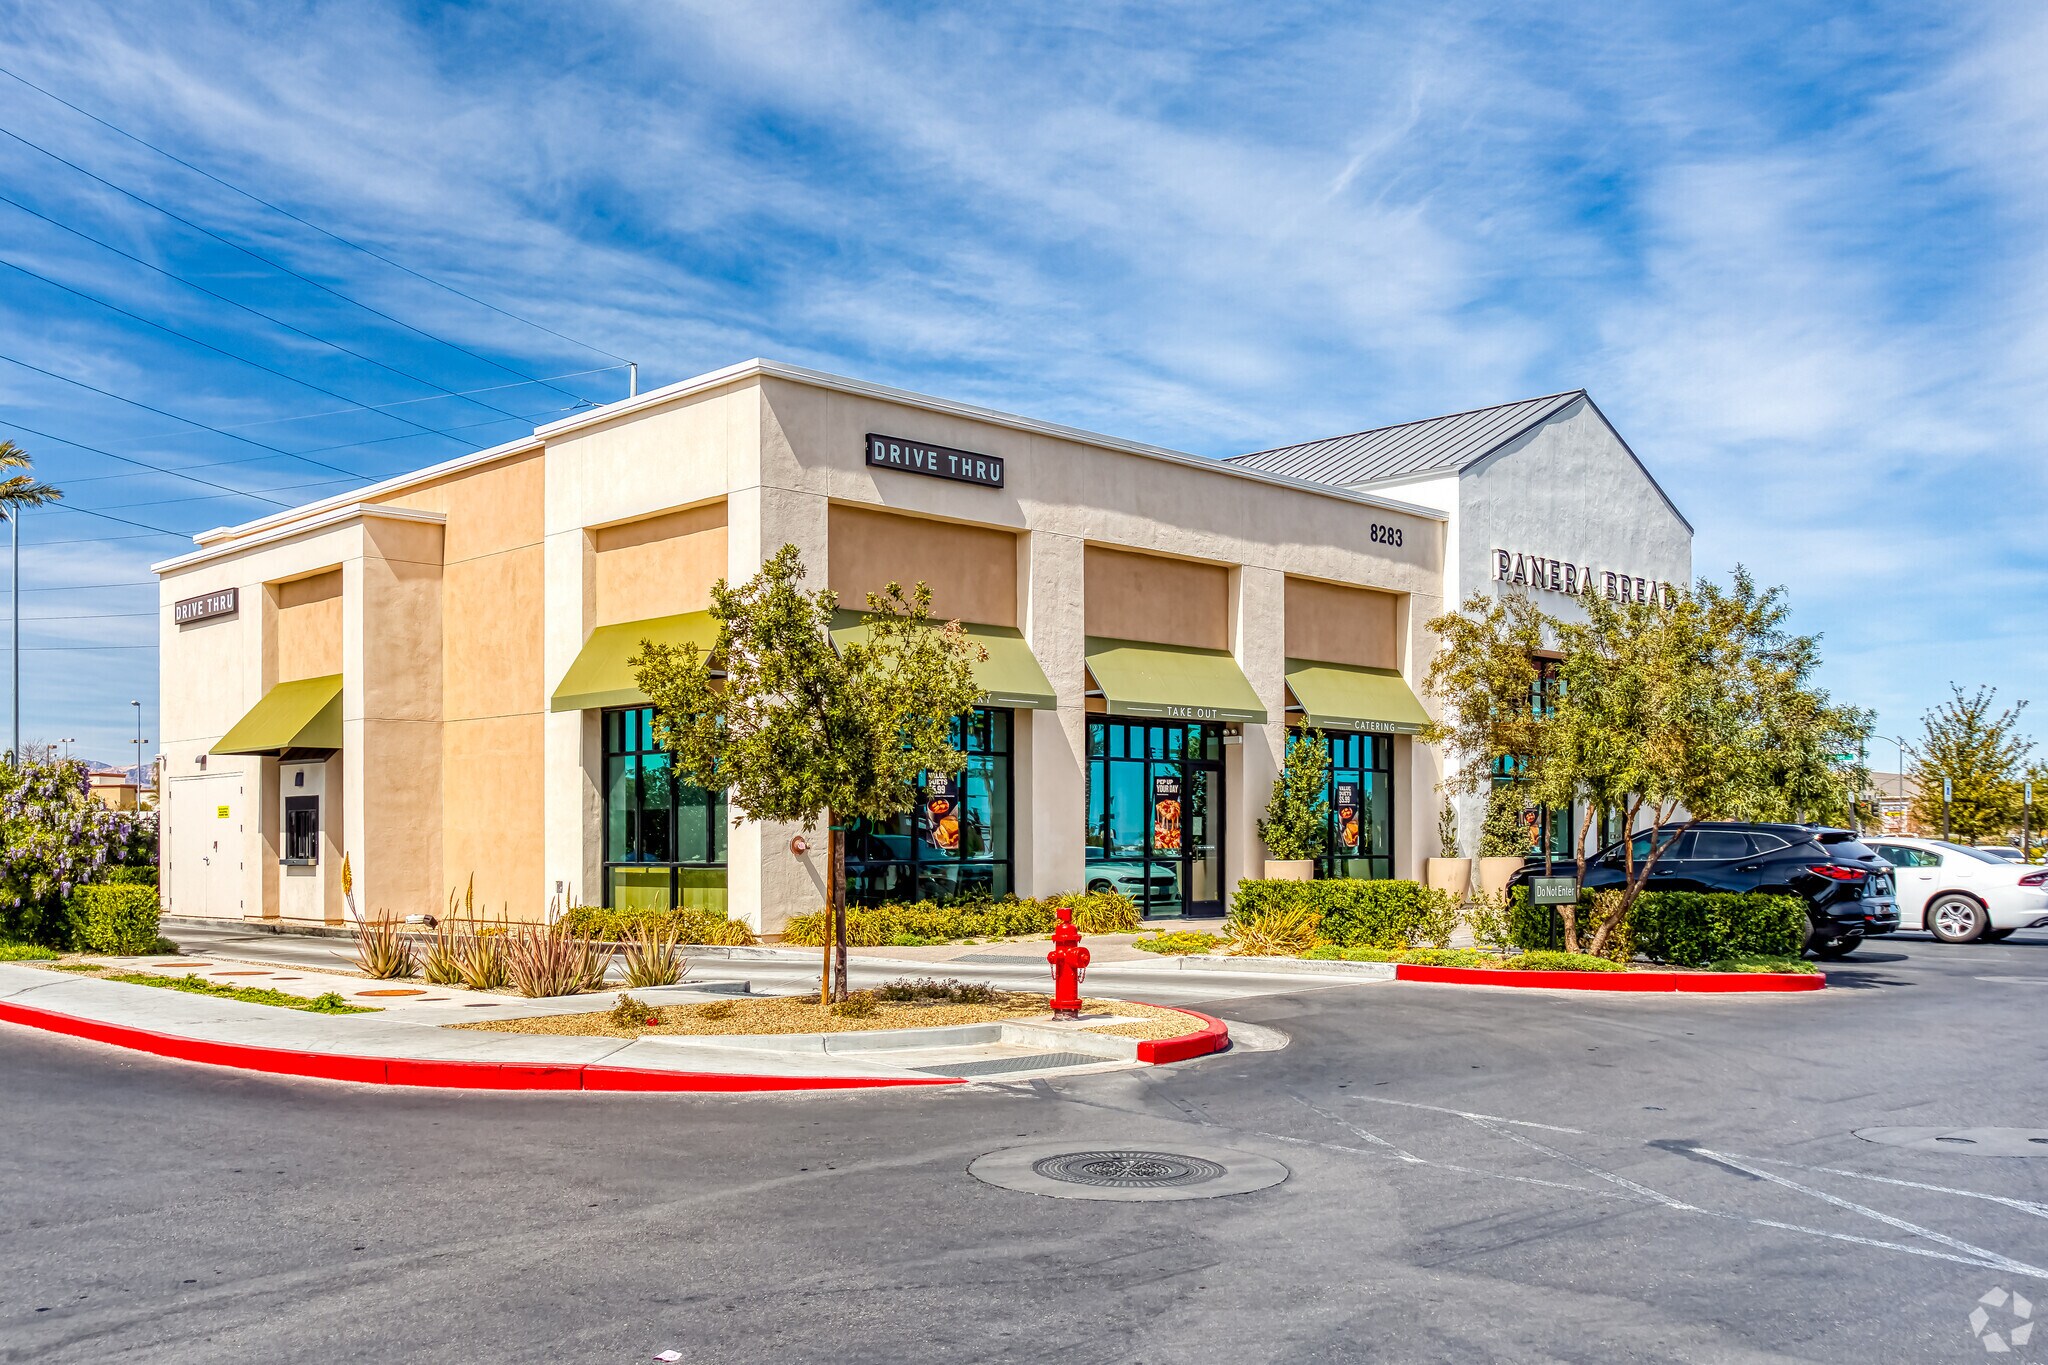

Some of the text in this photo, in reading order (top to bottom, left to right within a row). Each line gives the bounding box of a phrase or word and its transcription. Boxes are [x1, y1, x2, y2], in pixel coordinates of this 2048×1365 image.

[874, 441, 1000, 482] DRIVE THRU
[1370, 523, 1403, 547] 8283
[1491, 548, 1595, 597] PANERA
[175, 593, 233, 621] DRIVE THRU
[1166, 706, 1217, 719] TAKE OUT
[1354, 720, 1395, 732] CATERING
[1536, 885, 1575, 897] Do Not Enter
